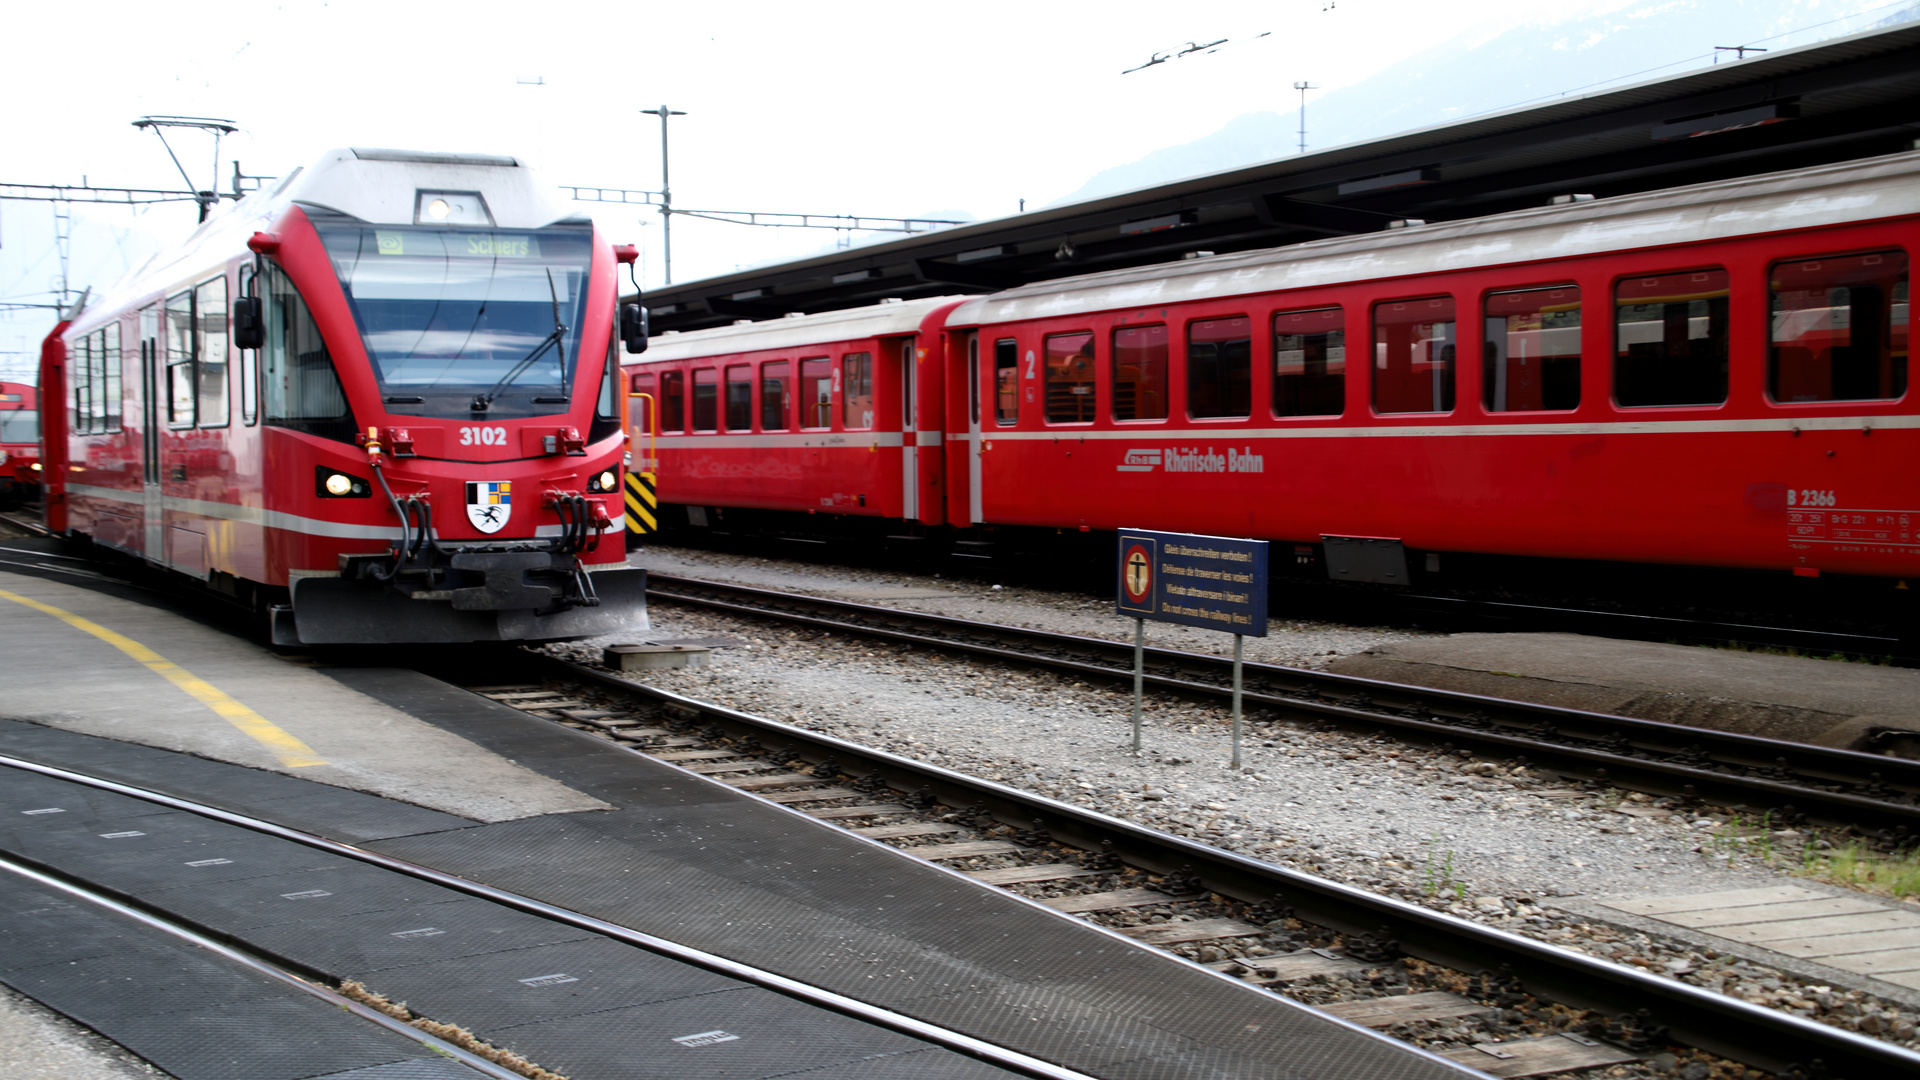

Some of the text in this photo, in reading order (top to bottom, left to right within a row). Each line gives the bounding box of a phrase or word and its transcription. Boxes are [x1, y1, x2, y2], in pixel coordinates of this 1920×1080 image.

[467, 235, 530, 256] Schiers
[1025, 350, 1036, 379] 2
[833, 367, 841, 392] 2
[459, 427, 507, 446] 3102
[1164, 446, 1264, 473] Rhätische Bahn
[1787, 489, 1836, 507] B 2366
[1164, 543, 1179, 555] Gleis
[1186, 566, 1194, 577] de
[1194, 567, 1222, 580] traverser
[1222, 570, 1232, 581] les
[1162, 602, 1171, 613] Do
[1171, 604, 1182, 614] not
[1182, 607, 1199, 617] cross
[1199, 607, 1209, 618] the
